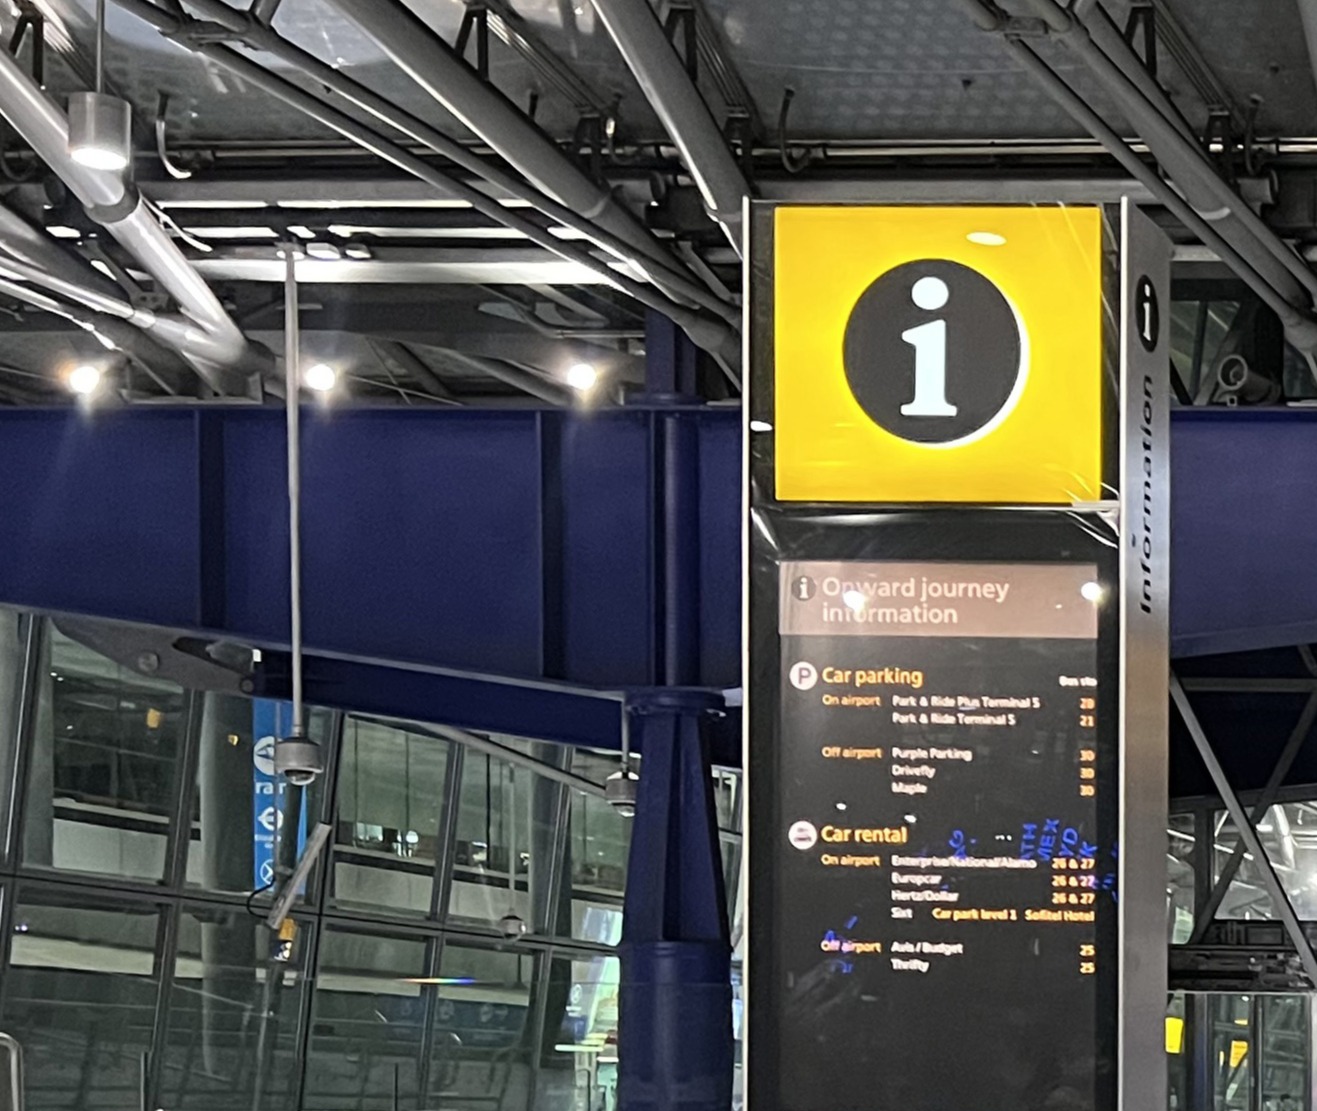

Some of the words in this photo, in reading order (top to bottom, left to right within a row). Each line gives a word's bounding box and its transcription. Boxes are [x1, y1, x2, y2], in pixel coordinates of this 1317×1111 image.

[1139, 375, 1154, 614] Information
[822, 577, 915, 598] Onward
[920, 577, 1009, 604] journey
[822, 603, 958, 623] information
[822, 667, 851, 683] Car
[855, 667, 923, 688] parking
[822, 694, 839, 705] On
[841, 695, 880, 708] airport
[892, 696, 916, 707] Park
[930, 696, 955, 707] Ride
[981, 696, 1030, 708] Terminal
[892, 713, 916, 724] Park
[930, 714, 955, 725] Ride
[957, 714, 1006, 725] Terminal
[821, 747, 841, 758] Off
[842, 747, 882, 760] airport
[892, 747, 928, 760] Purple
[930, 748, 972, 762] Parking
[821, 826, 853, 842] Car
[854, 826, 908, 843] rental
[821, 854, 838, 866] On
[840, 855, 880, 868] airport
[891, 872, 942, 885] Europcar
[932, 908, 952, 920] Car
[953, 909, 978, 922] park
[1064, 910, 1095, 922] Hotel
[820, 941, 840, 952] Off
[841, 941, 881, 954] airport
